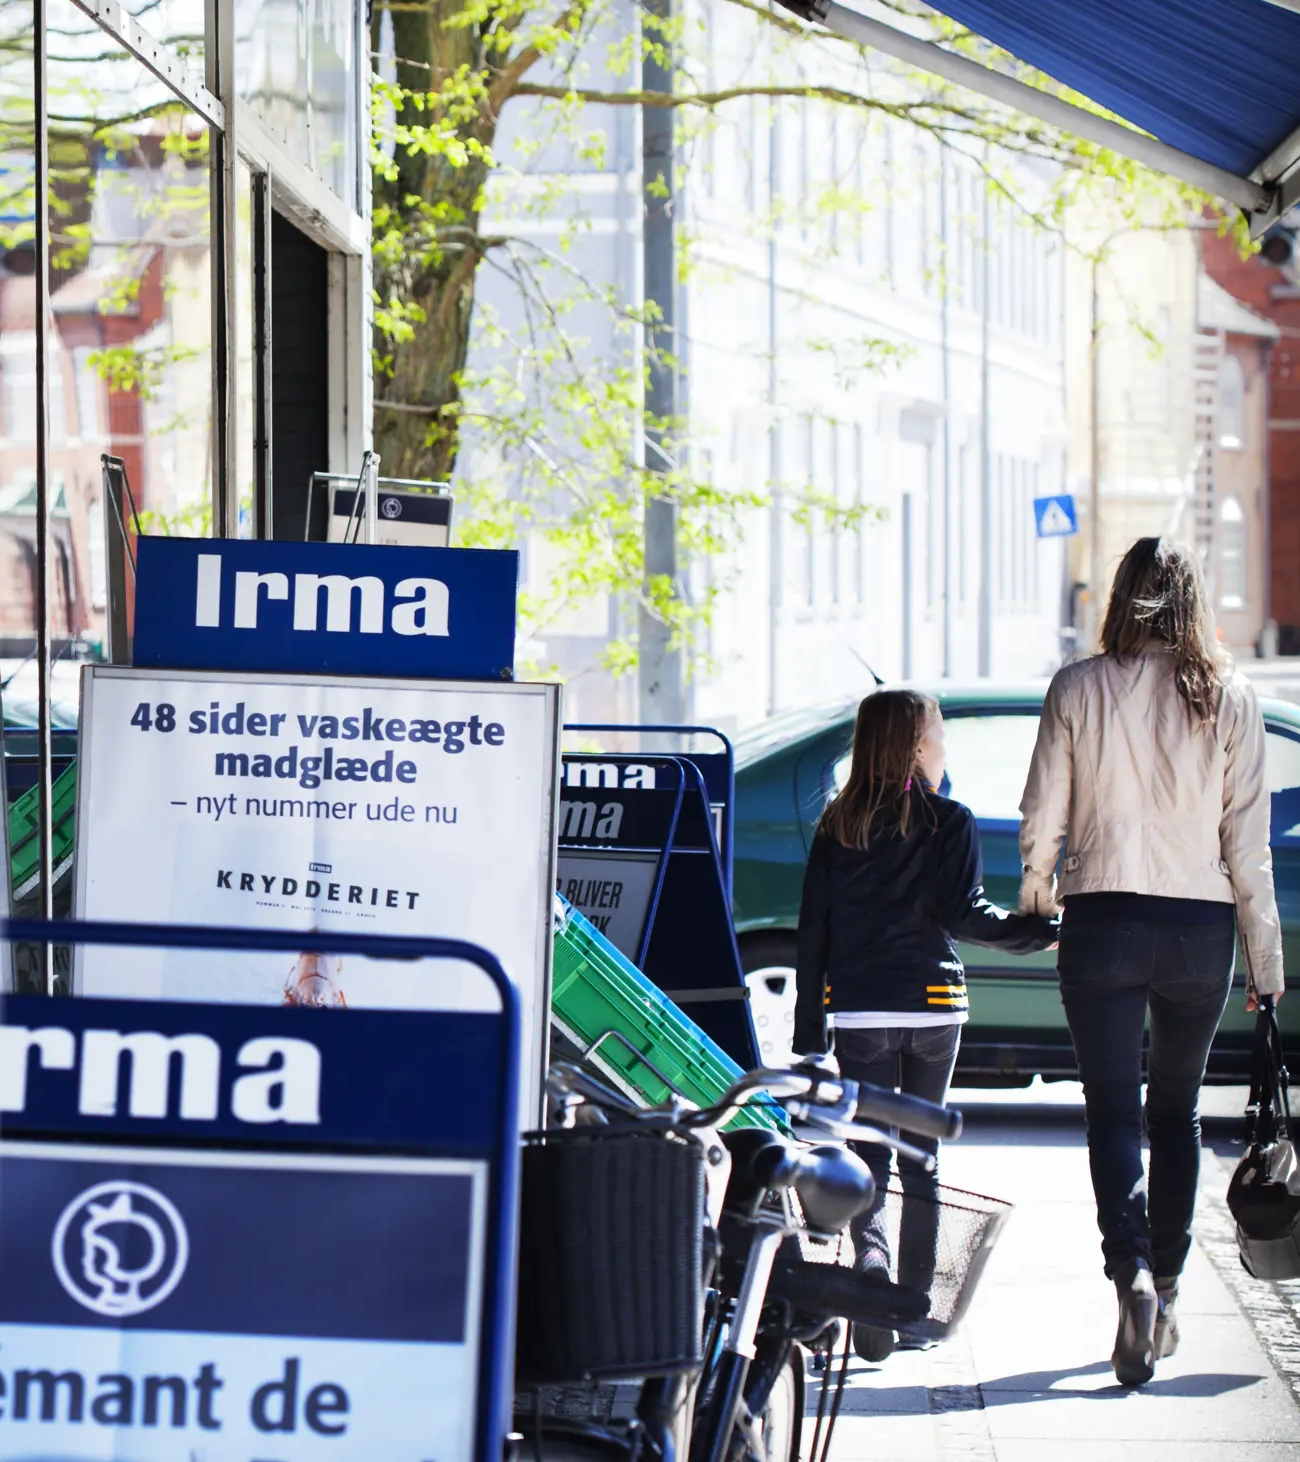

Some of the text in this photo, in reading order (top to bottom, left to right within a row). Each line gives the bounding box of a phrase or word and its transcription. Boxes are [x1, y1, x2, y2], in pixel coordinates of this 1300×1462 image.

[196, 554, 449, 636] Irma
[130, 701, 505, 754] 48 sider vaskeægte
[214, 745, 417, 789] madglæde
[560, 763, 655, 789] ma
[196, 793, 237, 822] nyt
[245, 797, 357, 820] nummer
[366, 796, 416, 822] ude
[424, 804, 458, 824] nu
[309, 863, 331, 873] Irma
[217, 869, 419, 910] KRYDDERIET
[566, 878, 623, 908] BLIVER
[251, 1356, 349, 1436] de
